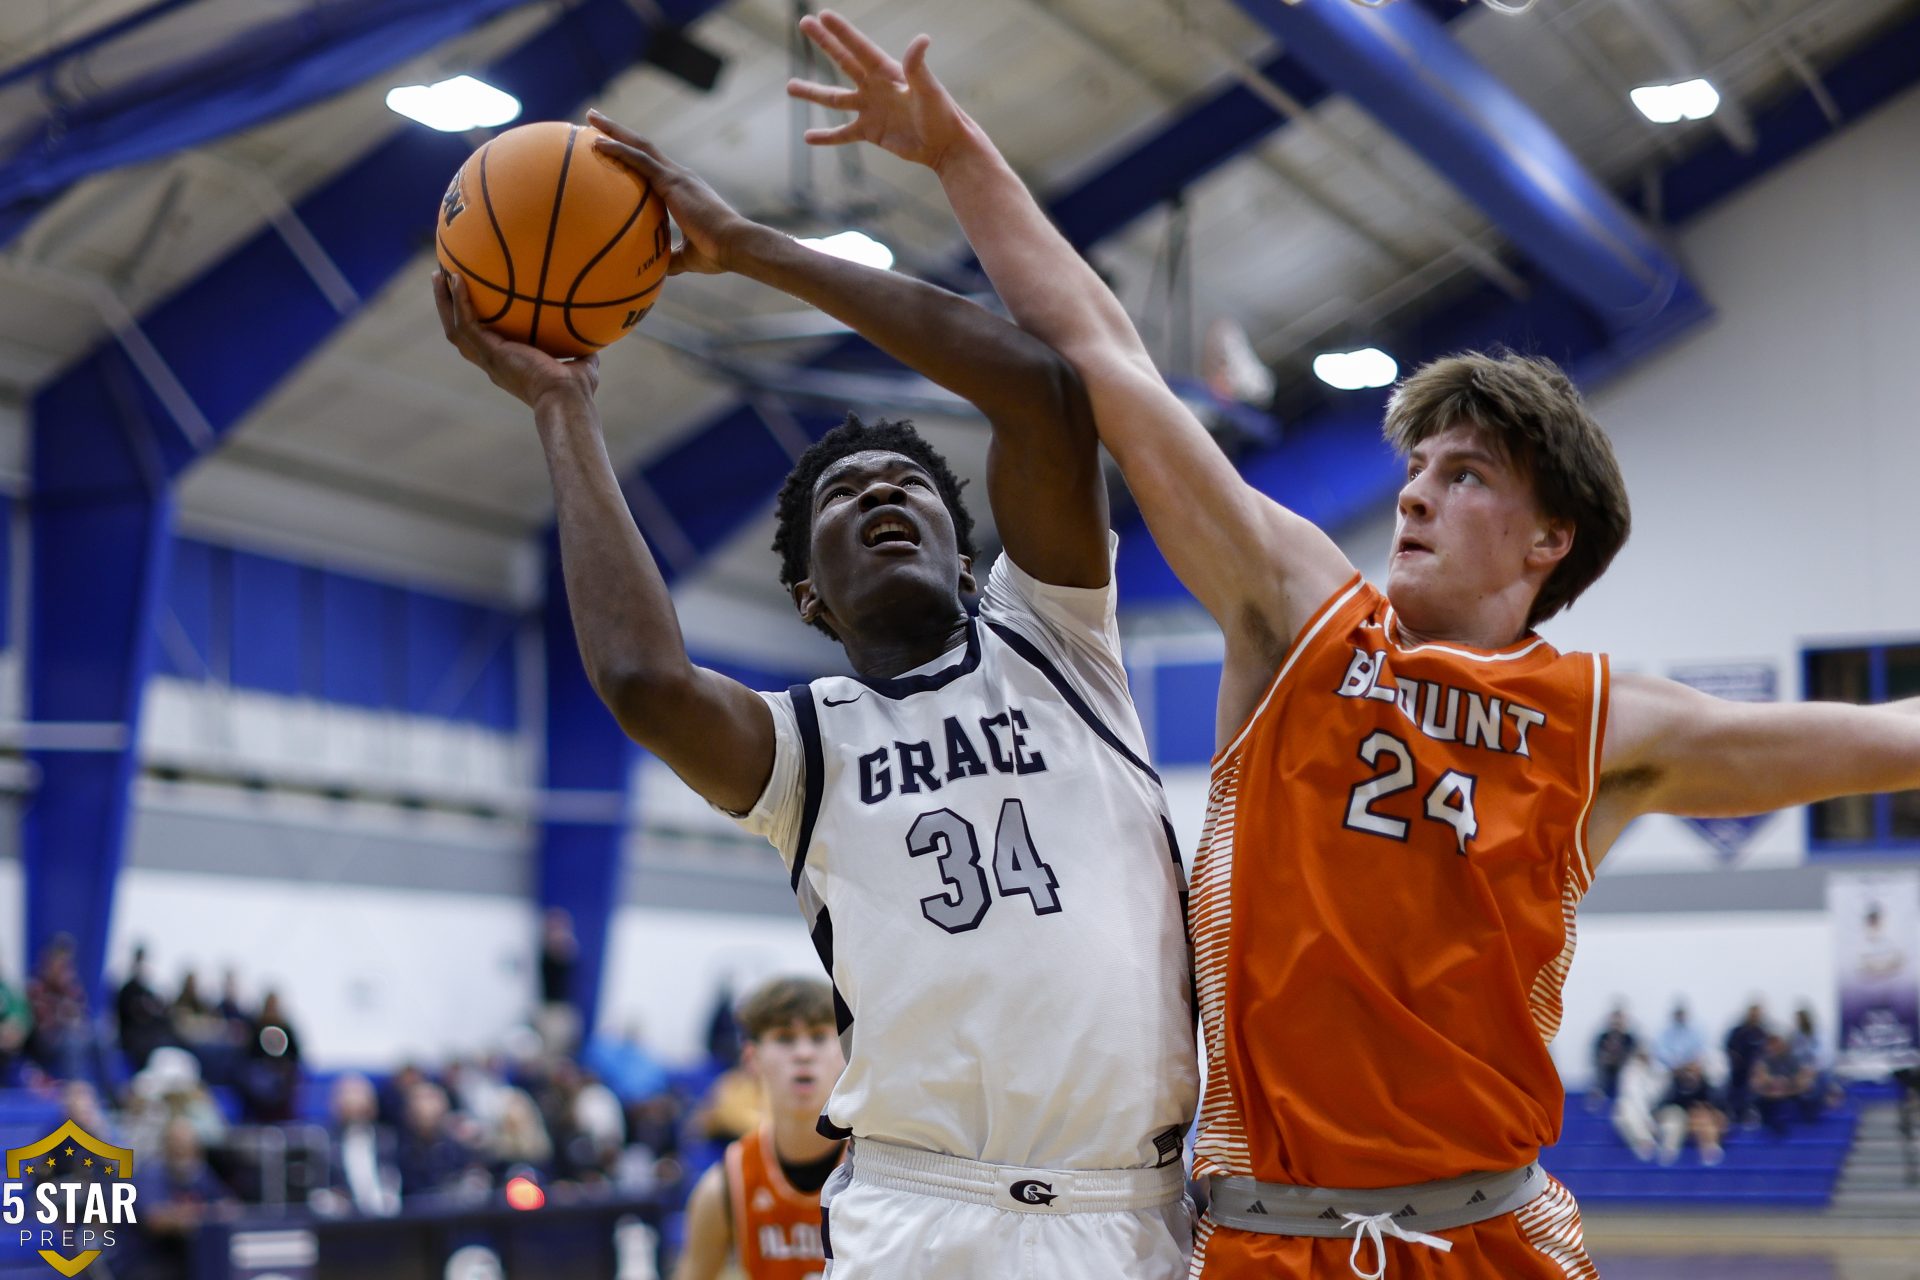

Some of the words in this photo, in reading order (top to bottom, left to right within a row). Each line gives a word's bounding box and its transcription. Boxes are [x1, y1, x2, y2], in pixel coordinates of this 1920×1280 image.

[858, 706, 1049, 804] GRACE
[1333, 648, 1546, 760] BLOUNT
[1342, 728, 1479, 856] 24
[905, 798, 1062, 934] 34
